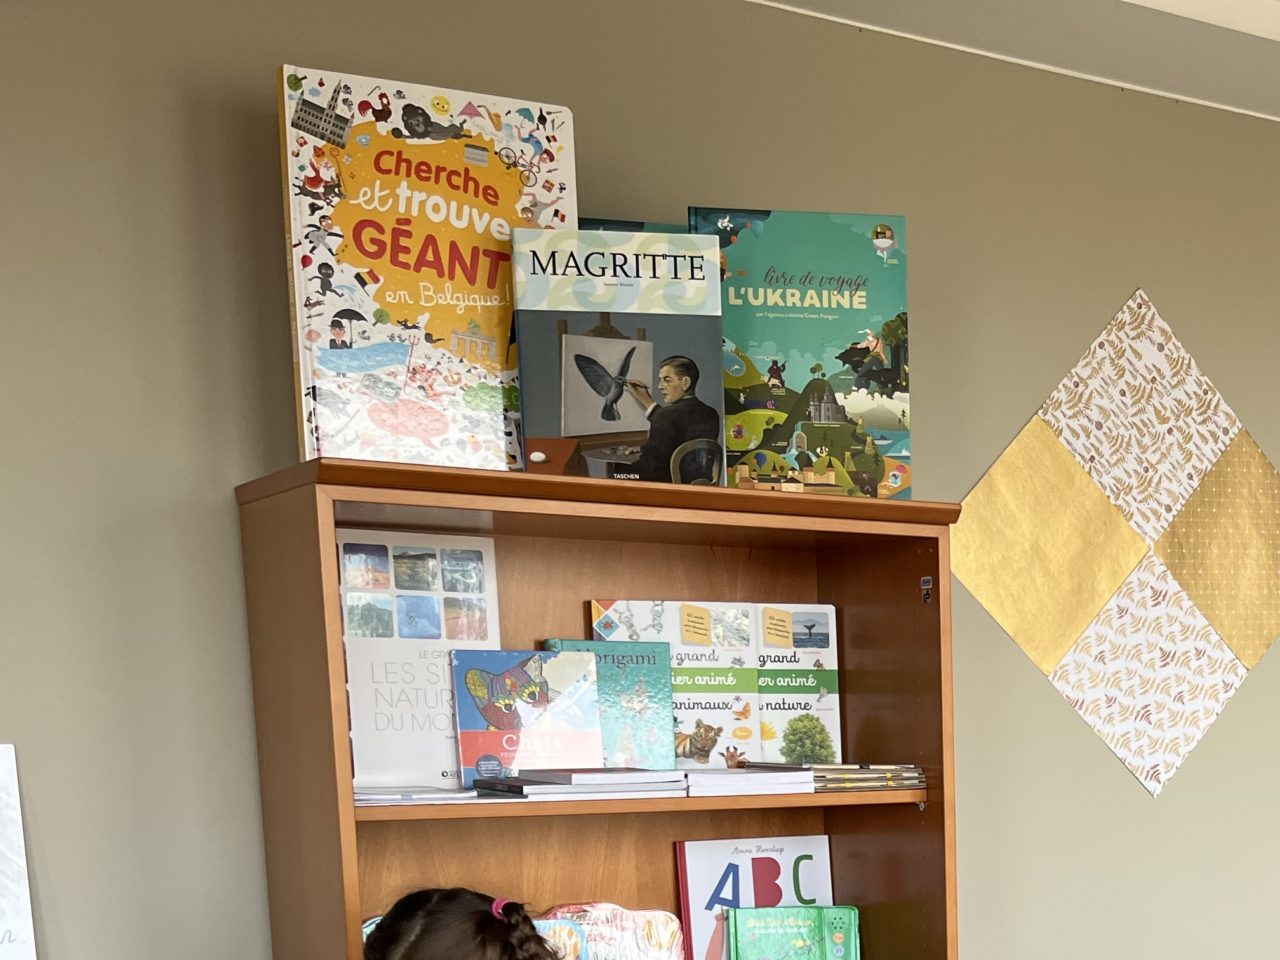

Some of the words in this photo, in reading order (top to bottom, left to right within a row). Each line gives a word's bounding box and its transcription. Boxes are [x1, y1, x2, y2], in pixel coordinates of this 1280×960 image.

[373, 150, 500, 206] Cherche
[349, 180, 393, 212] et
[395, 180, 511, 241] trouve
[352, 217, 511, 289] GÉANT
[529, 250, 706, 281] MAGRITTE
[763, 265, 796, 286] livre
[799, 271, 816, 287] de
[819, 274, 870, 297] voyage
[385, 291, 414, 304] en
[728, 286, 867, 309] L'UKRAINE
[431, 650, 450, 659] GRA
[577, 649, 657, 669] origami
[675, 649, 719, 666] grand
[758, 651, 800, 667] grand
[371, 662, 415, 684] LES
[672, 671, 692, 685] ier
[694, 671, 737, 685] animé
[758, 675, 775, 686] er
[776, 677, 817, 686] animé
[374, 688, 455, 709] NATUR
[672, 699, 733, 710] animaux
[765, 699, 812, 711] nature
[374, 713, 404, 731] DU
